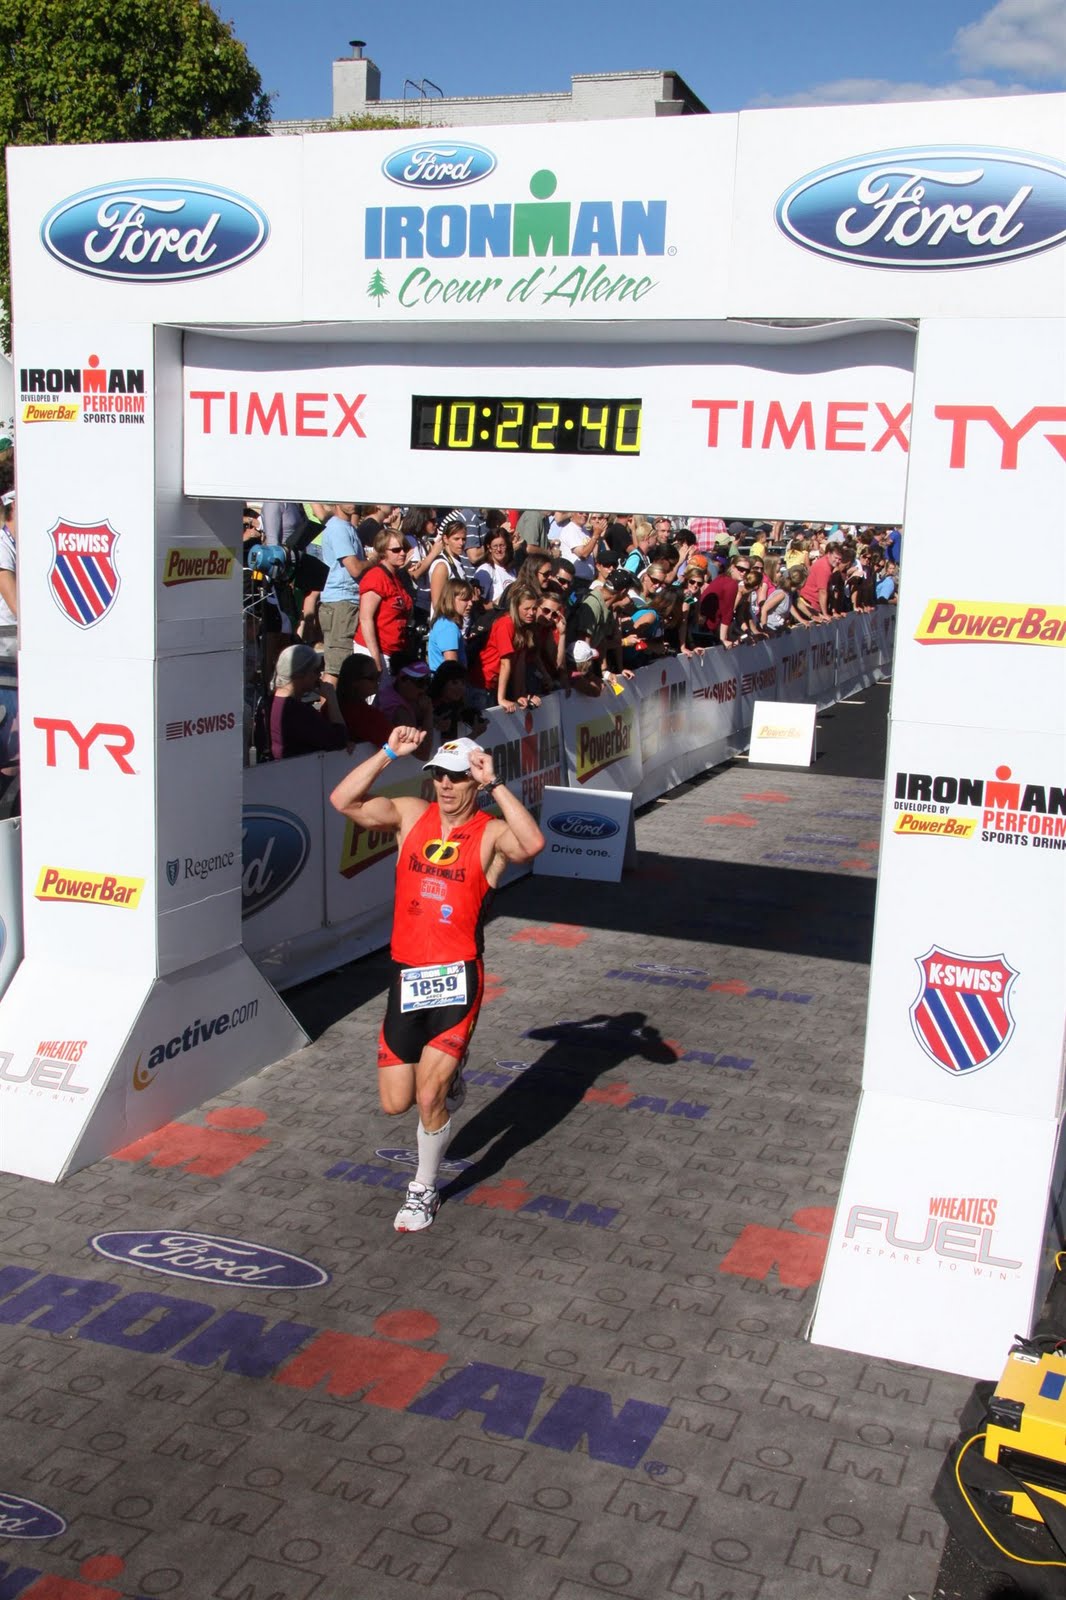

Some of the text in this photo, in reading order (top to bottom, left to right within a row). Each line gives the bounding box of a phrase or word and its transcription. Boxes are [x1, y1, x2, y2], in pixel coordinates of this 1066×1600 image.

[403, 149, 474, 182] Ford
[836, 166, 1034, 249] Ford
[84, 197, 222, 265] Ford
[365, 200, 667, 259] IRONMAN
[399, 266, 503, 308] Coeur
[20, 368, 144, 393] IRONMAN
[20, 394, 60, 402] DEVELOPED BY
[26, 404, 76, 420] PowerBar
[83, 395, 145, 412] PERFORM
[190, 391, 367, 438] TIMEX
[83, 413, 145, 424] SPORTS DRINK
[692, 399, 911, 453] TIMEX
[168, 549, 232, 577] PowerBar
[33, 717, 136, 775] TYR
[580, 714, 632, 769] PowerBar
[893, 802, 950, 815] DEVELOPED BY
[894, 772, 1066, 816] IRONMAN
[561, 815, 606, 836] Ford
[898, 813, 971, 835] PowerBar
[981, 830, 1028, 846] SPORTS
[982, 810, 1066, 838] PERFORM
[184, 851, 234, 880] Regence
[551, 844, 611, 858] Drive one.
[41, 869, 138, 904] PowerBar
[409, 976, 458, 997] 1859
[147, 999, 259, 1069] active.com
[36, 1040, 88, 1062] WHEATIES
[0, 1051, 89, 1094] UEL
[929, 1197, 998, 1226] WHEATIES
[844, 1205, 1023, 1270] FUEL
[129, 1235, 286, 1281] Ford
[841, 1243, 1007, 1280] PREPARE TO WIN
[0, 1265, 671, 1469] IRONMAN
